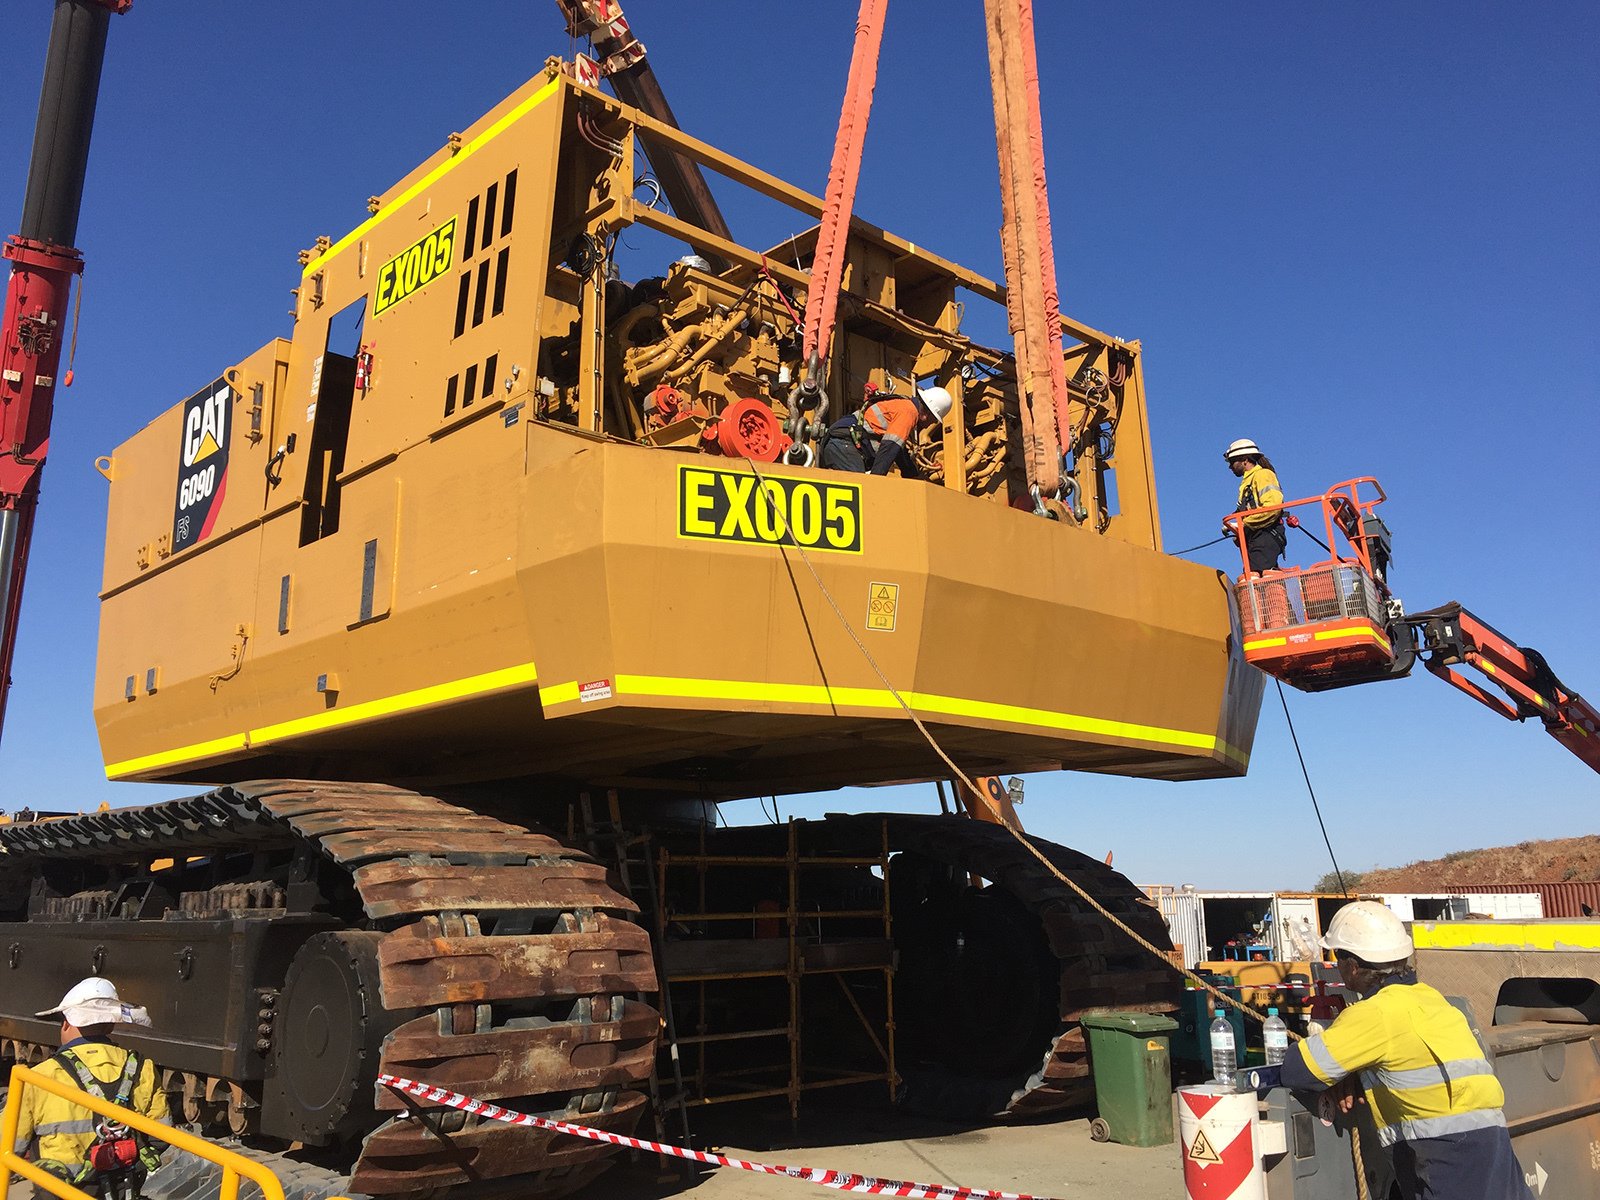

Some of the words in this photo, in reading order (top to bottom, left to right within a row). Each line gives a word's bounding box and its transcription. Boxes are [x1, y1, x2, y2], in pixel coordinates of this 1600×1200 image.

[376, 222, 453, 313] EX005
[183, 385, 230, 467] CAT
[179, 464, 216, 510] 6090
[685, 470, 856, 548] EX005
[176, 515, 191, 543] FS
[586, 681, 605, 690] DANGER
